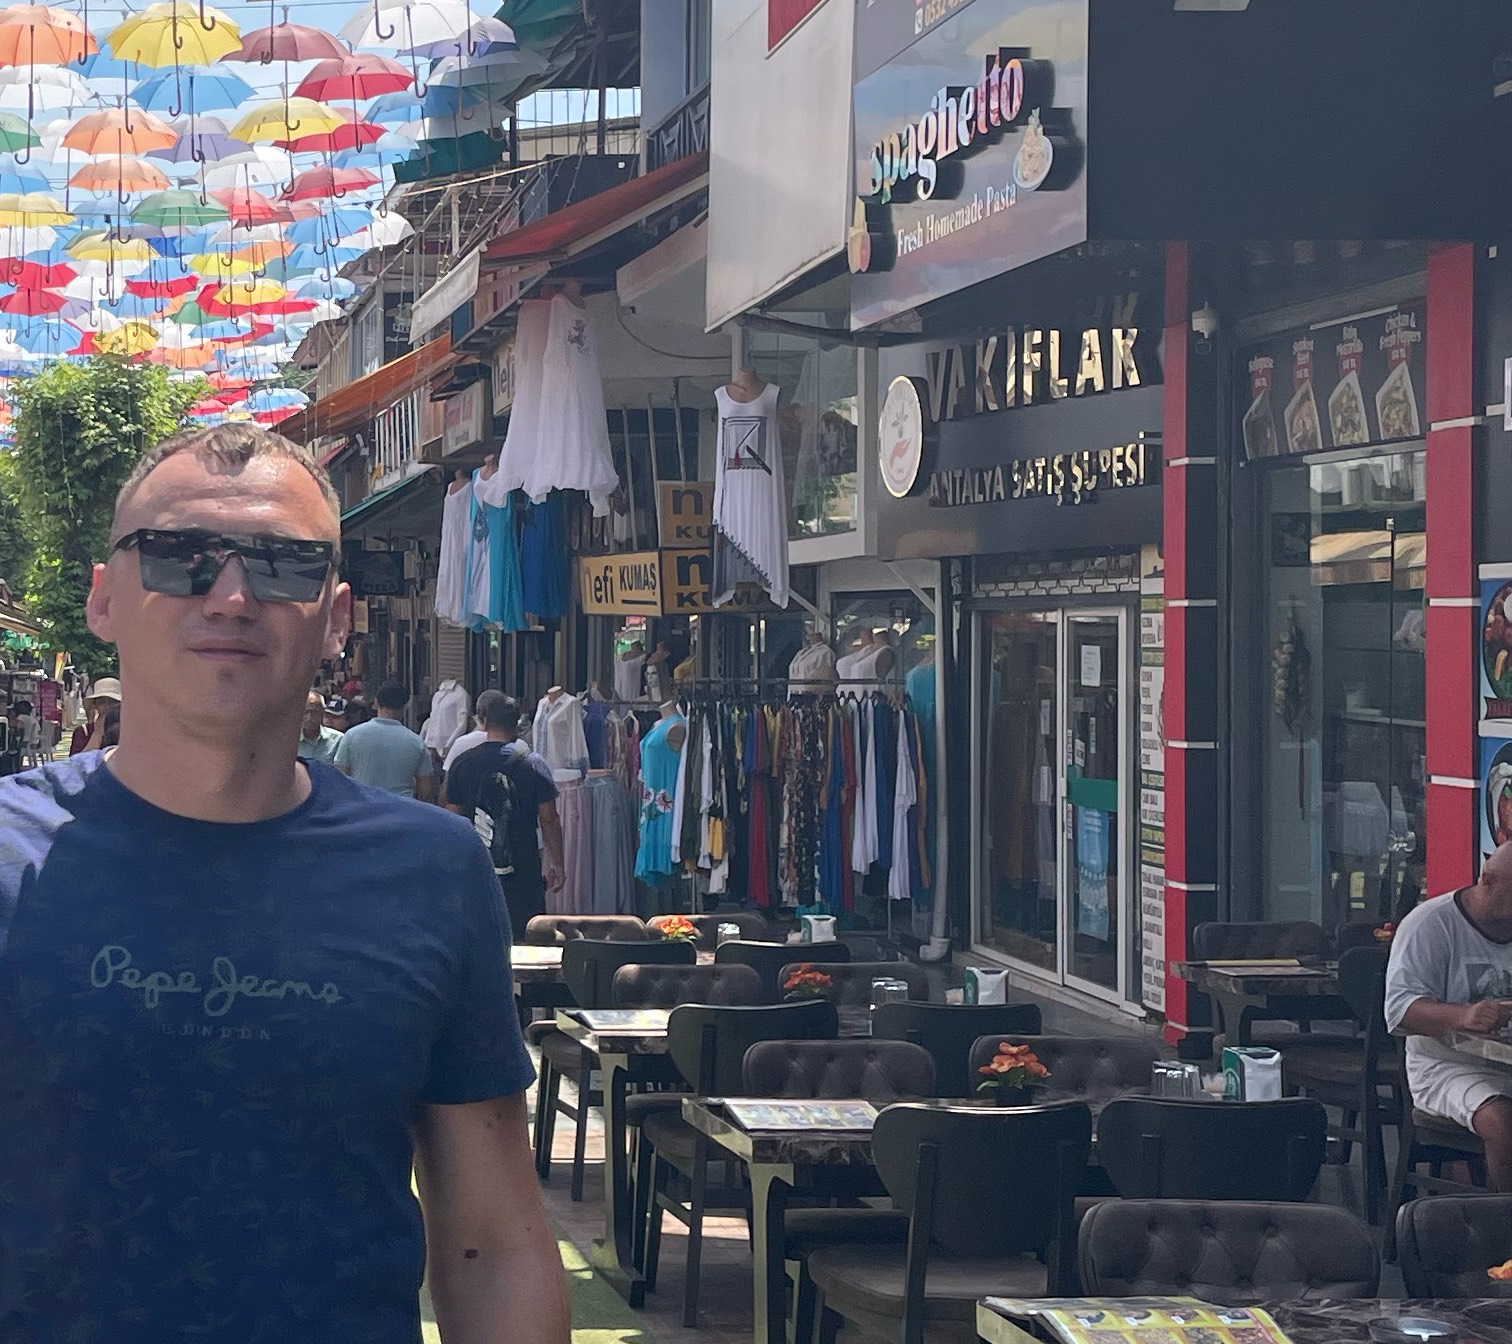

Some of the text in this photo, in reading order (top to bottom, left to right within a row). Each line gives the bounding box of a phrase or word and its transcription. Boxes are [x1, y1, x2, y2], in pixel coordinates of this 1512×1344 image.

[897, 182, 1018, 257] Fresh Homemade Pasta
[928, 464, 1005, 507] ANTALYA
[619, 562, 657, 597] KUMAŞ
[90, 945, 344, 1017] Pepe Jeans
